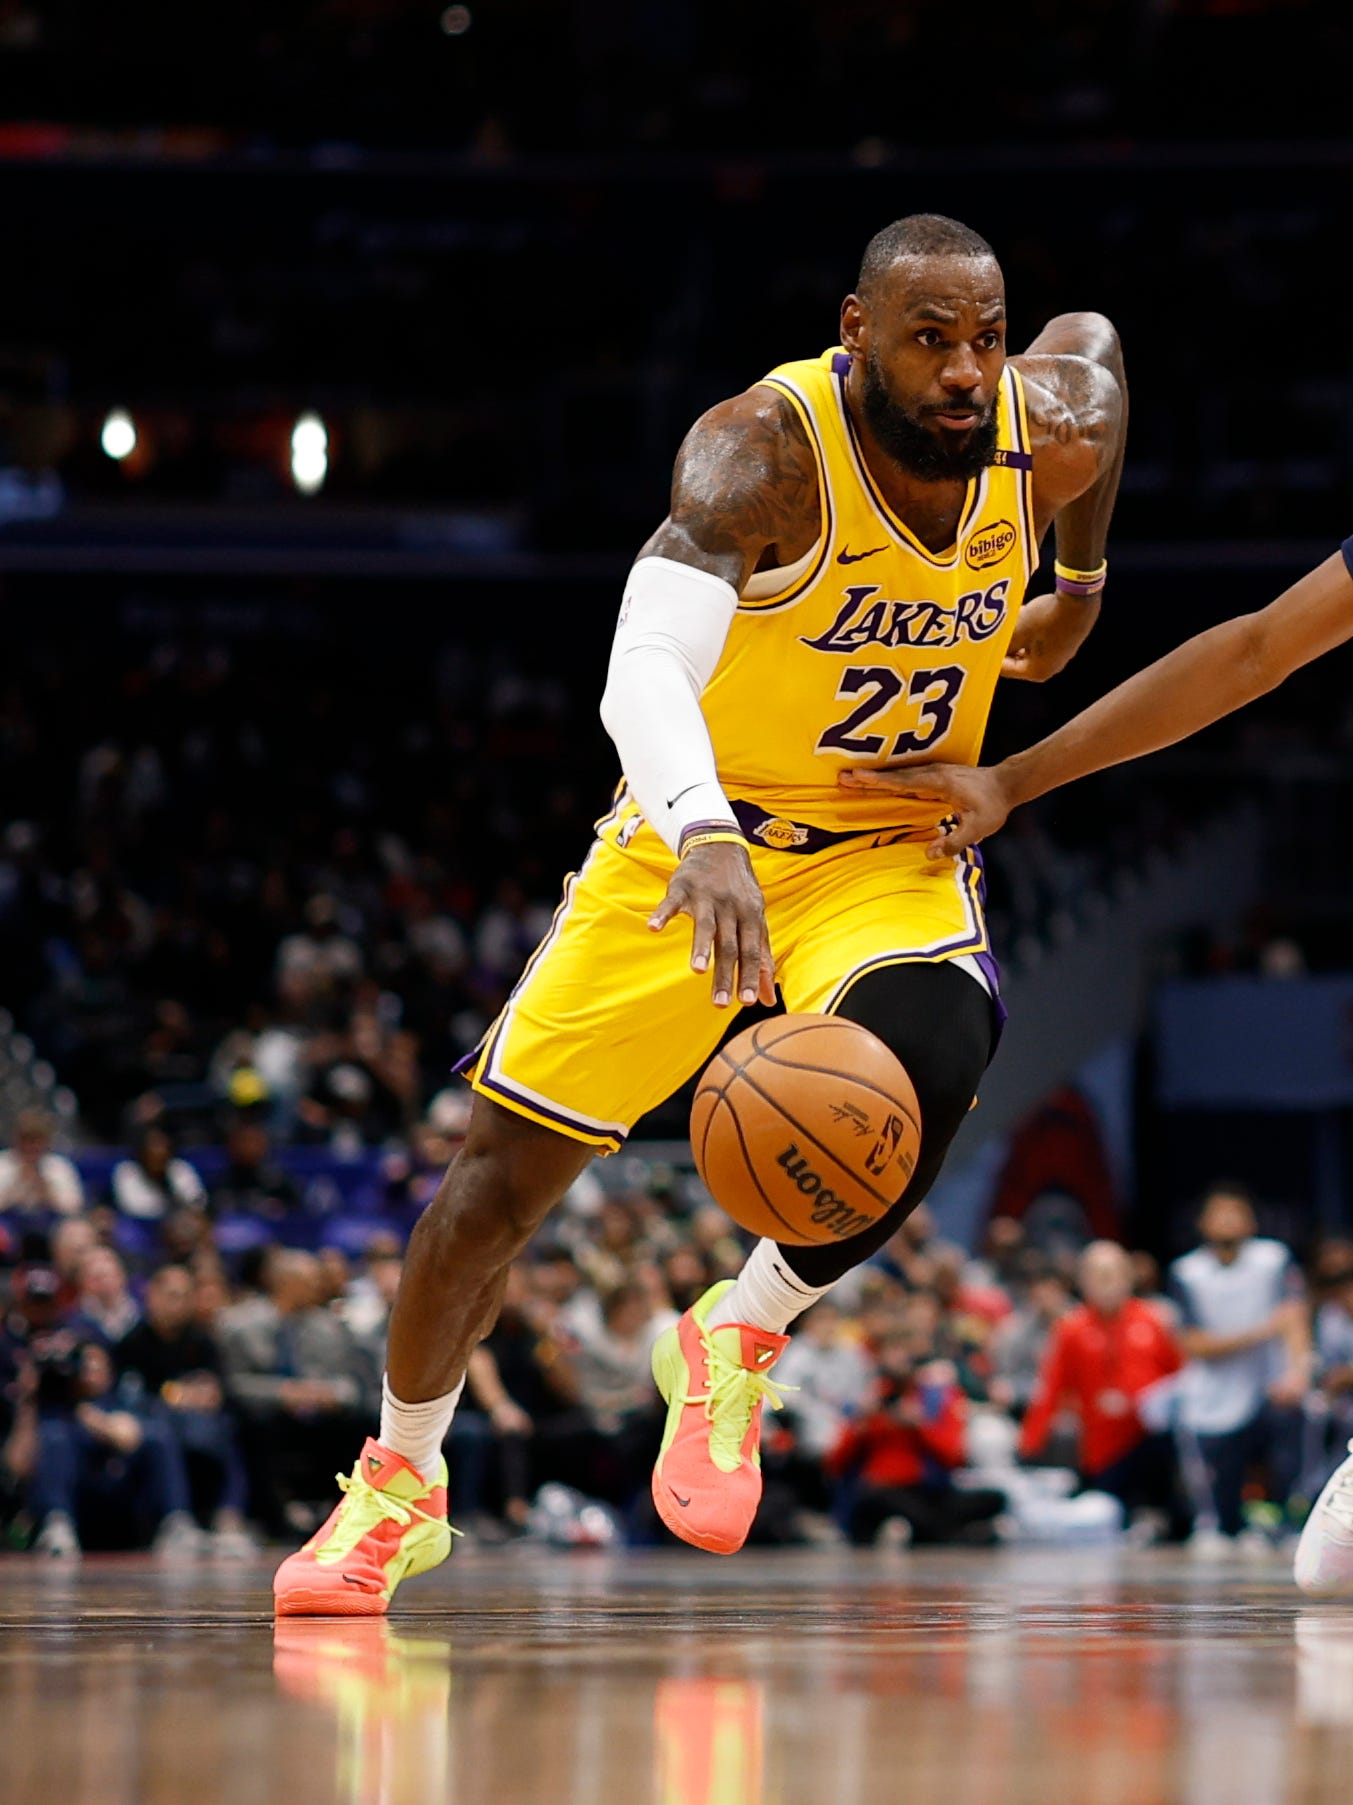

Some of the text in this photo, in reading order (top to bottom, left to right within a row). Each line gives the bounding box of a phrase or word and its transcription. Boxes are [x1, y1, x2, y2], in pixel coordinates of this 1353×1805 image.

[969, 531, 1014, 558] bibigo
[800, 577, 1013, 654] LAKERS
[815, 663, 967, 762] 23
